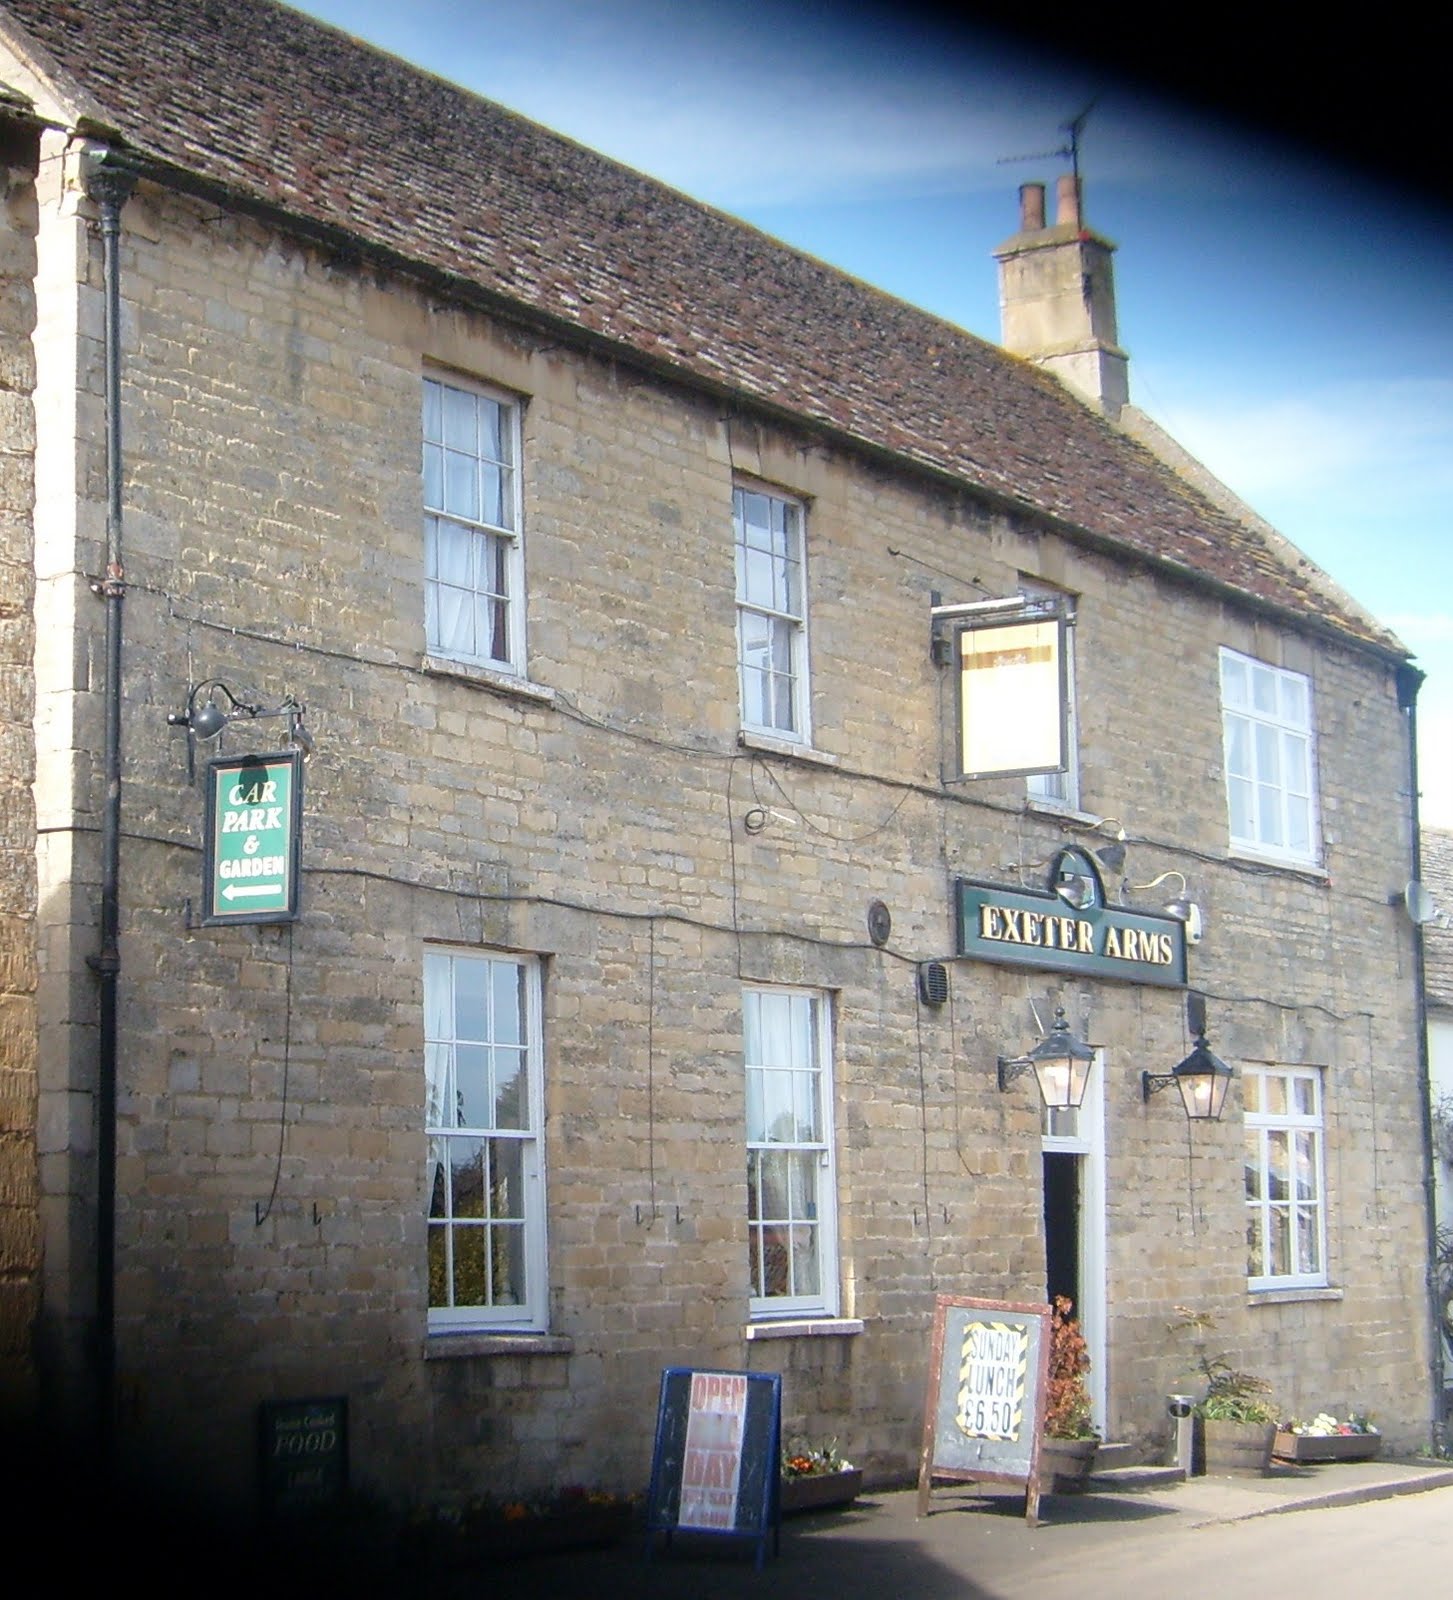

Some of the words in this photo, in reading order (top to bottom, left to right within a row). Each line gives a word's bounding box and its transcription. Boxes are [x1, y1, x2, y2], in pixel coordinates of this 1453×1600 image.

[229, 781, 277, 806] CAR
[222, 807, 284, 832] PARK
[243, 835, 260, 854] &
[219, 856, 285, 879] GARDEN
[979, 904, 1094, 954] EXETER
[1103, 926, 1173, 965] ARMS
[970, 1329, 1018, 1360] SUNDAY
[694, 1376, 745, 1411] OPEN
[968, 1364, 1016, 1398] LUNCH
[964, 1400, 1011, 1434] £6.50
[685, 1452, 738, 1488] DAY
